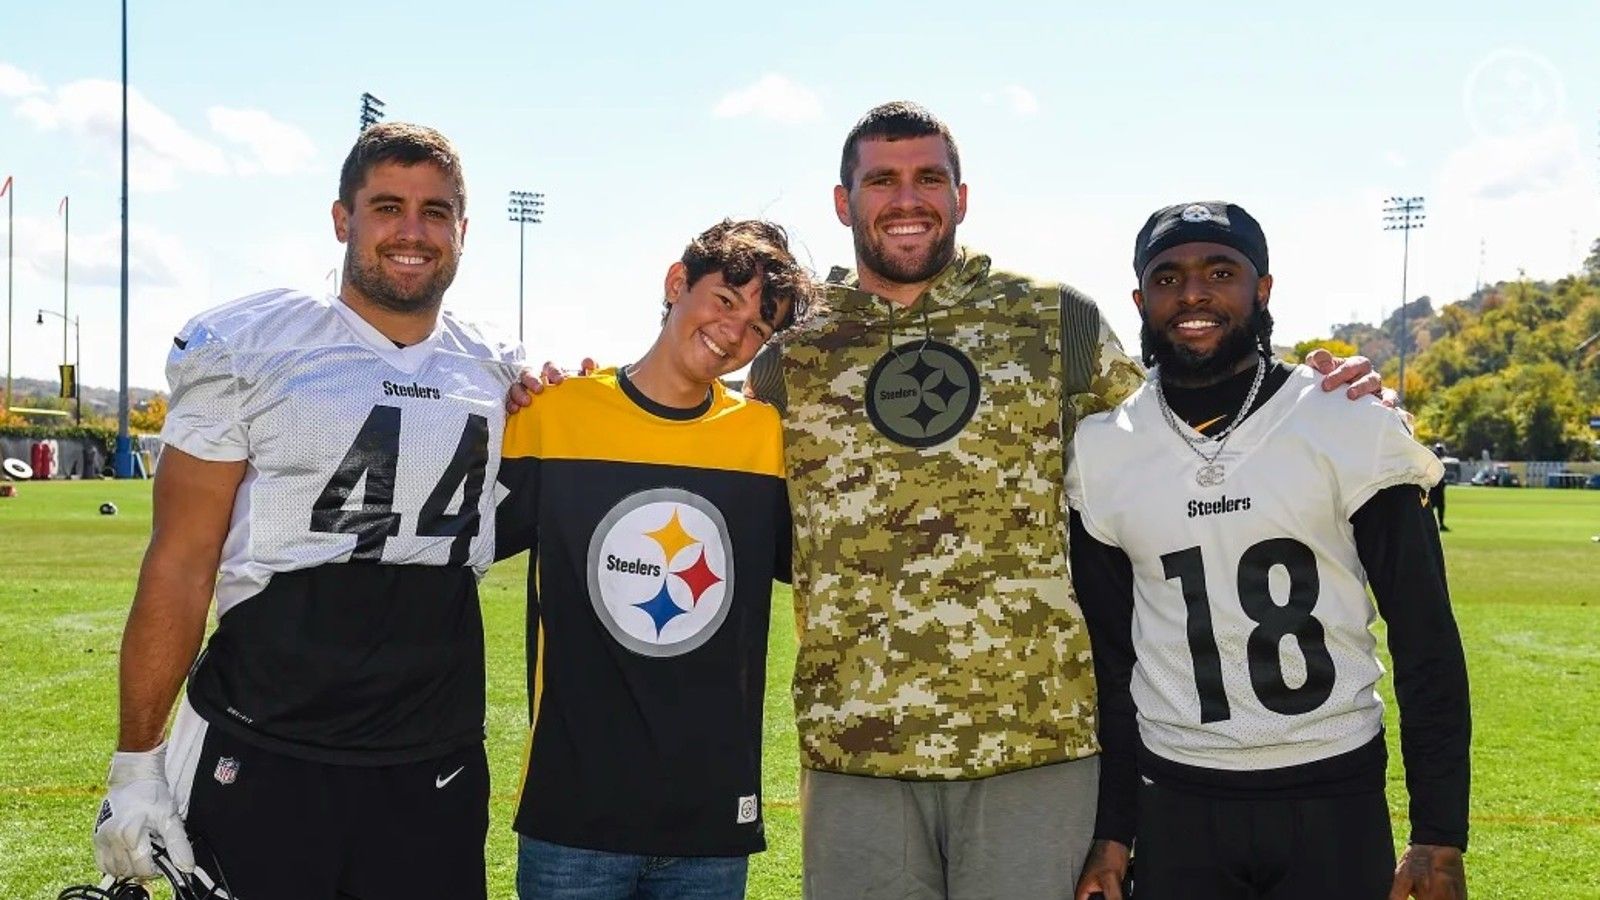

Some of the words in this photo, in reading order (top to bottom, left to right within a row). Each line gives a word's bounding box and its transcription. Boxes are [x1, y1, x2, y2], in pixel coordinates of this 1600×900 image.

[382, 380, 441, 400] Steelers
[880, 388, 918, 400] Steelers
[309, 404, 489, 565] 44
[1187, 495, 1251, 518] Steelers
[606, 554, 661, 577] Steelers
[1159, 537, 1336, 724] 18
